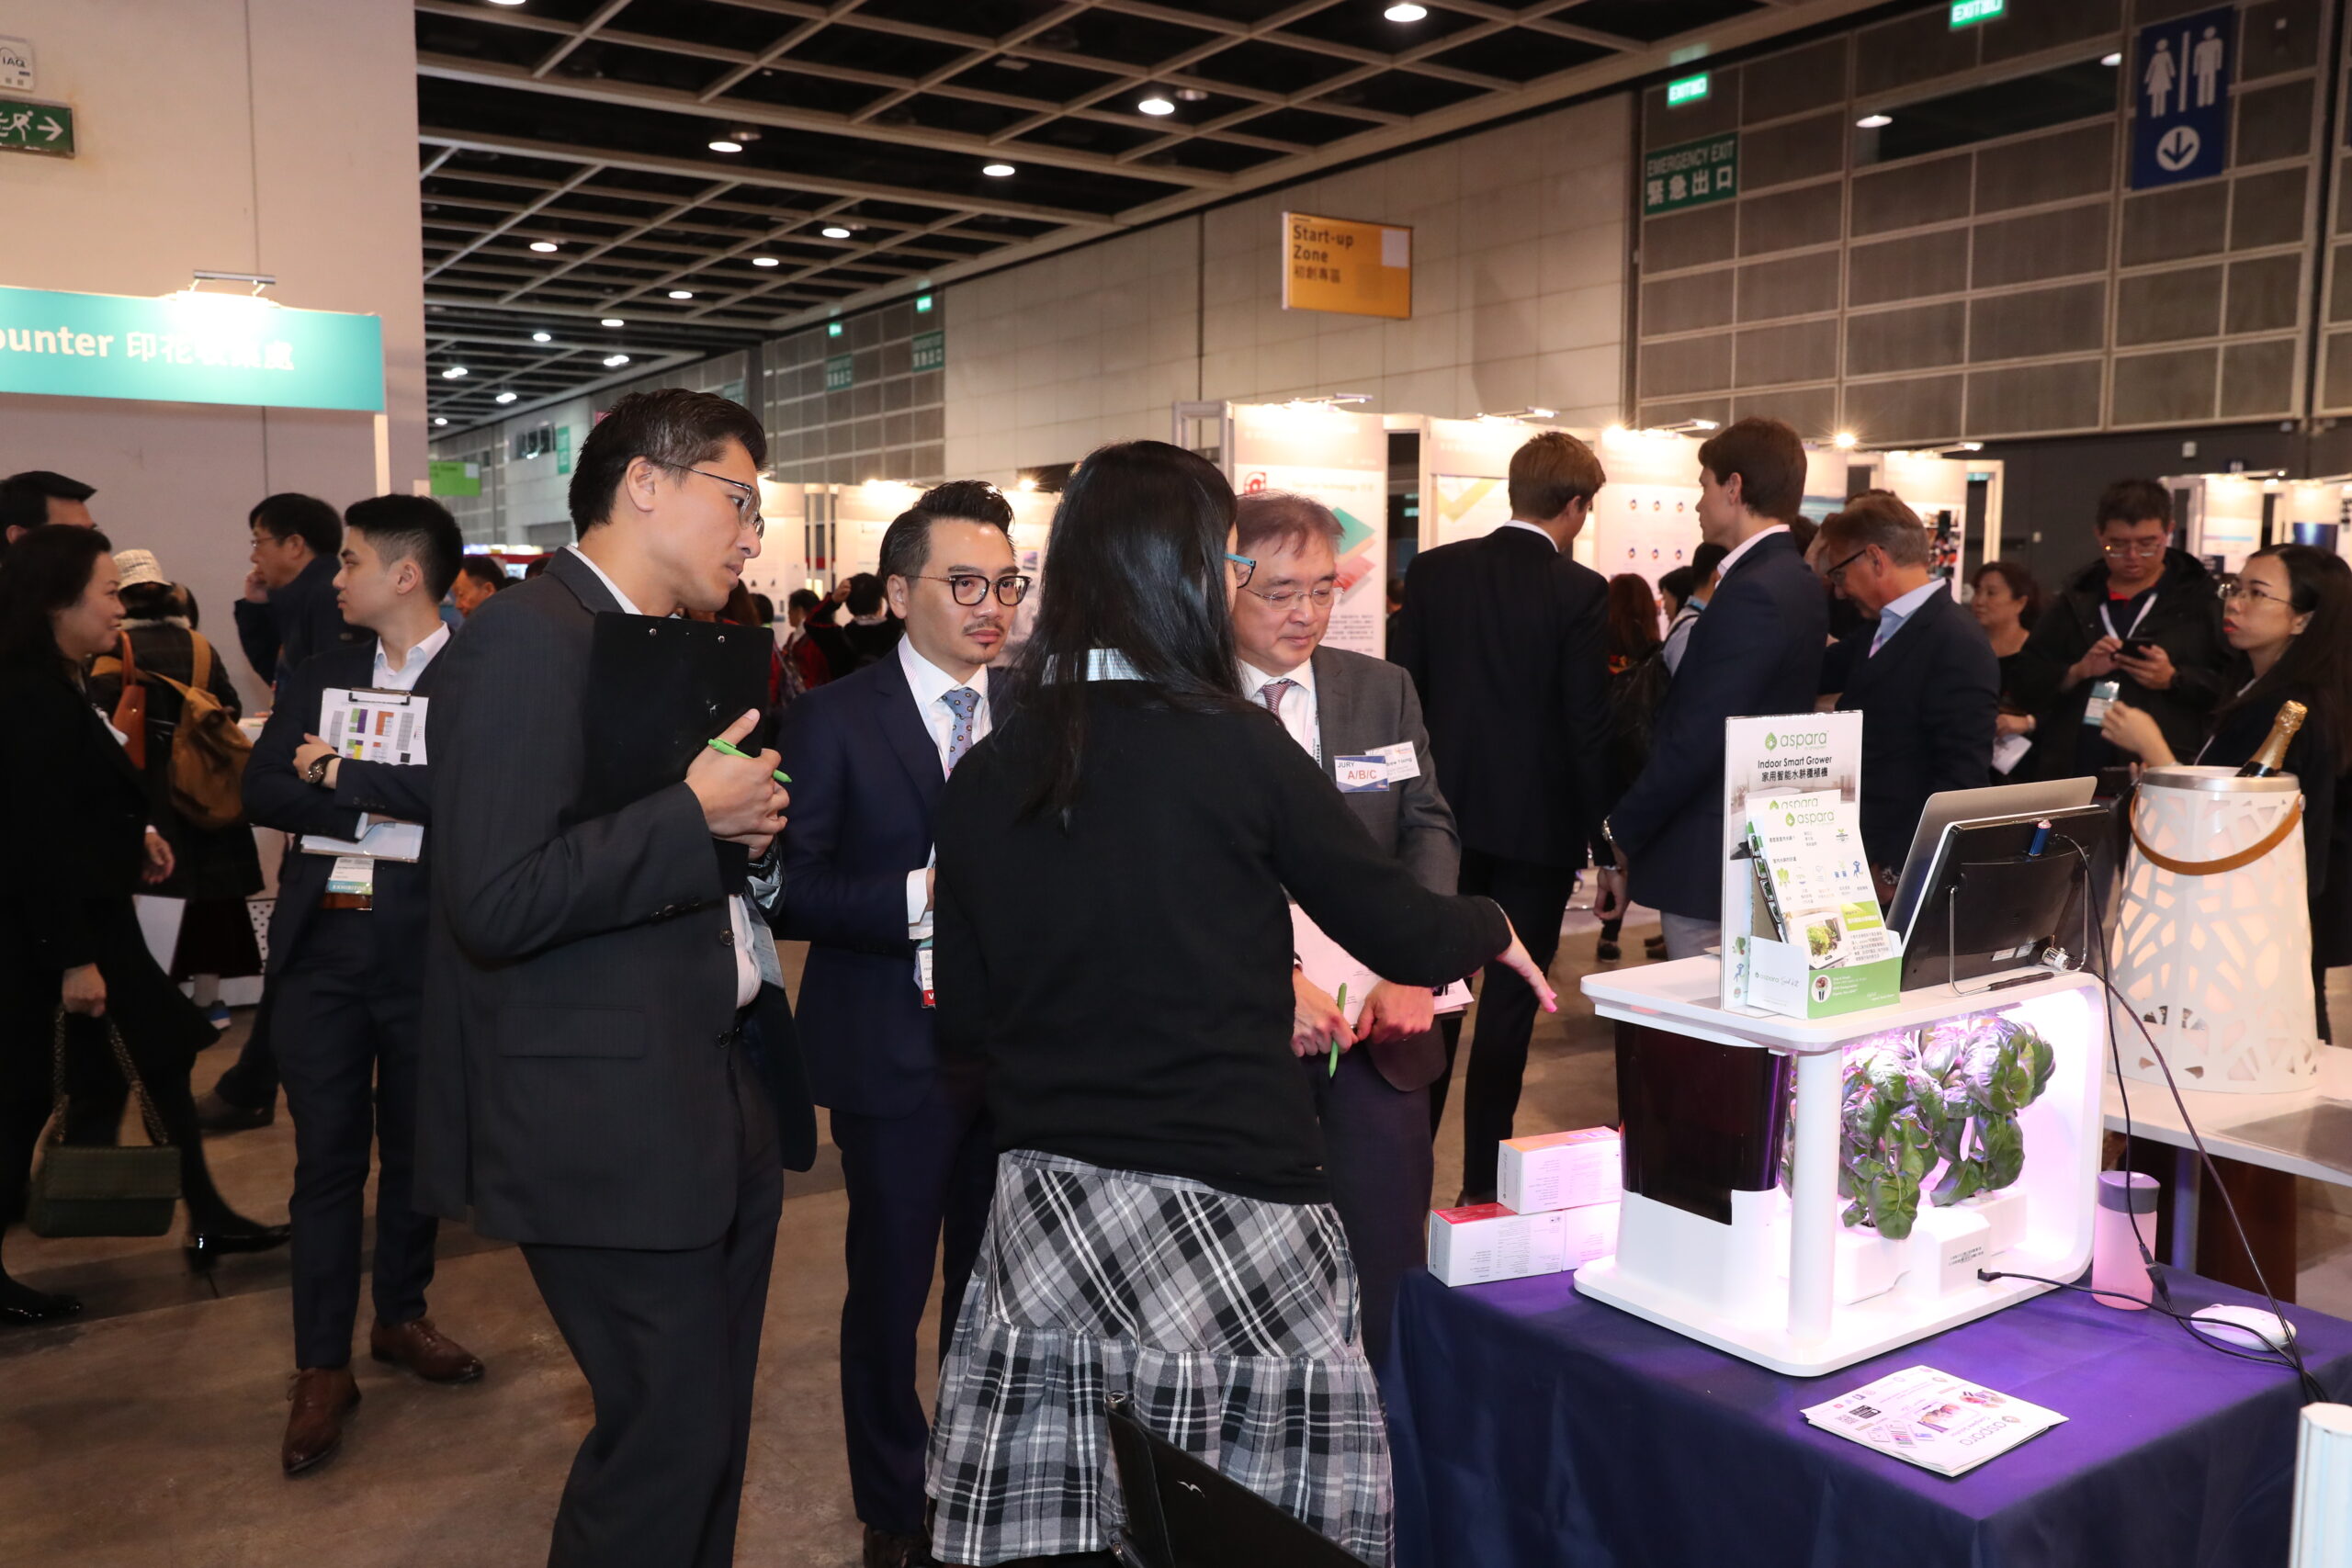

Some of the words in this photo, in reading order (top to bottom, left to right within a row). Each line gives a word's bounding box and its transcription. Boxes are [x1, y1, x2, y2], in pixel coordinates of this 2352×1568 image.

[1647, 147, 1709, 177] EMERGENCY
[1711, 141, 1735, 163] EXIT
[1294, 225, 1353, 248] Start-up
[1294, 244, 1329, 263] Zone
[1781, 731, 1828, 750] aspara
[1758, 758, 1781, 769] Indoor
[1783, 756, 1804, 767] Smart
[1806, 755, 1833, 765] Grower
[1348, 770, 1377, 780] A/B/C
[1797, 811, 1835, 826] aspara
